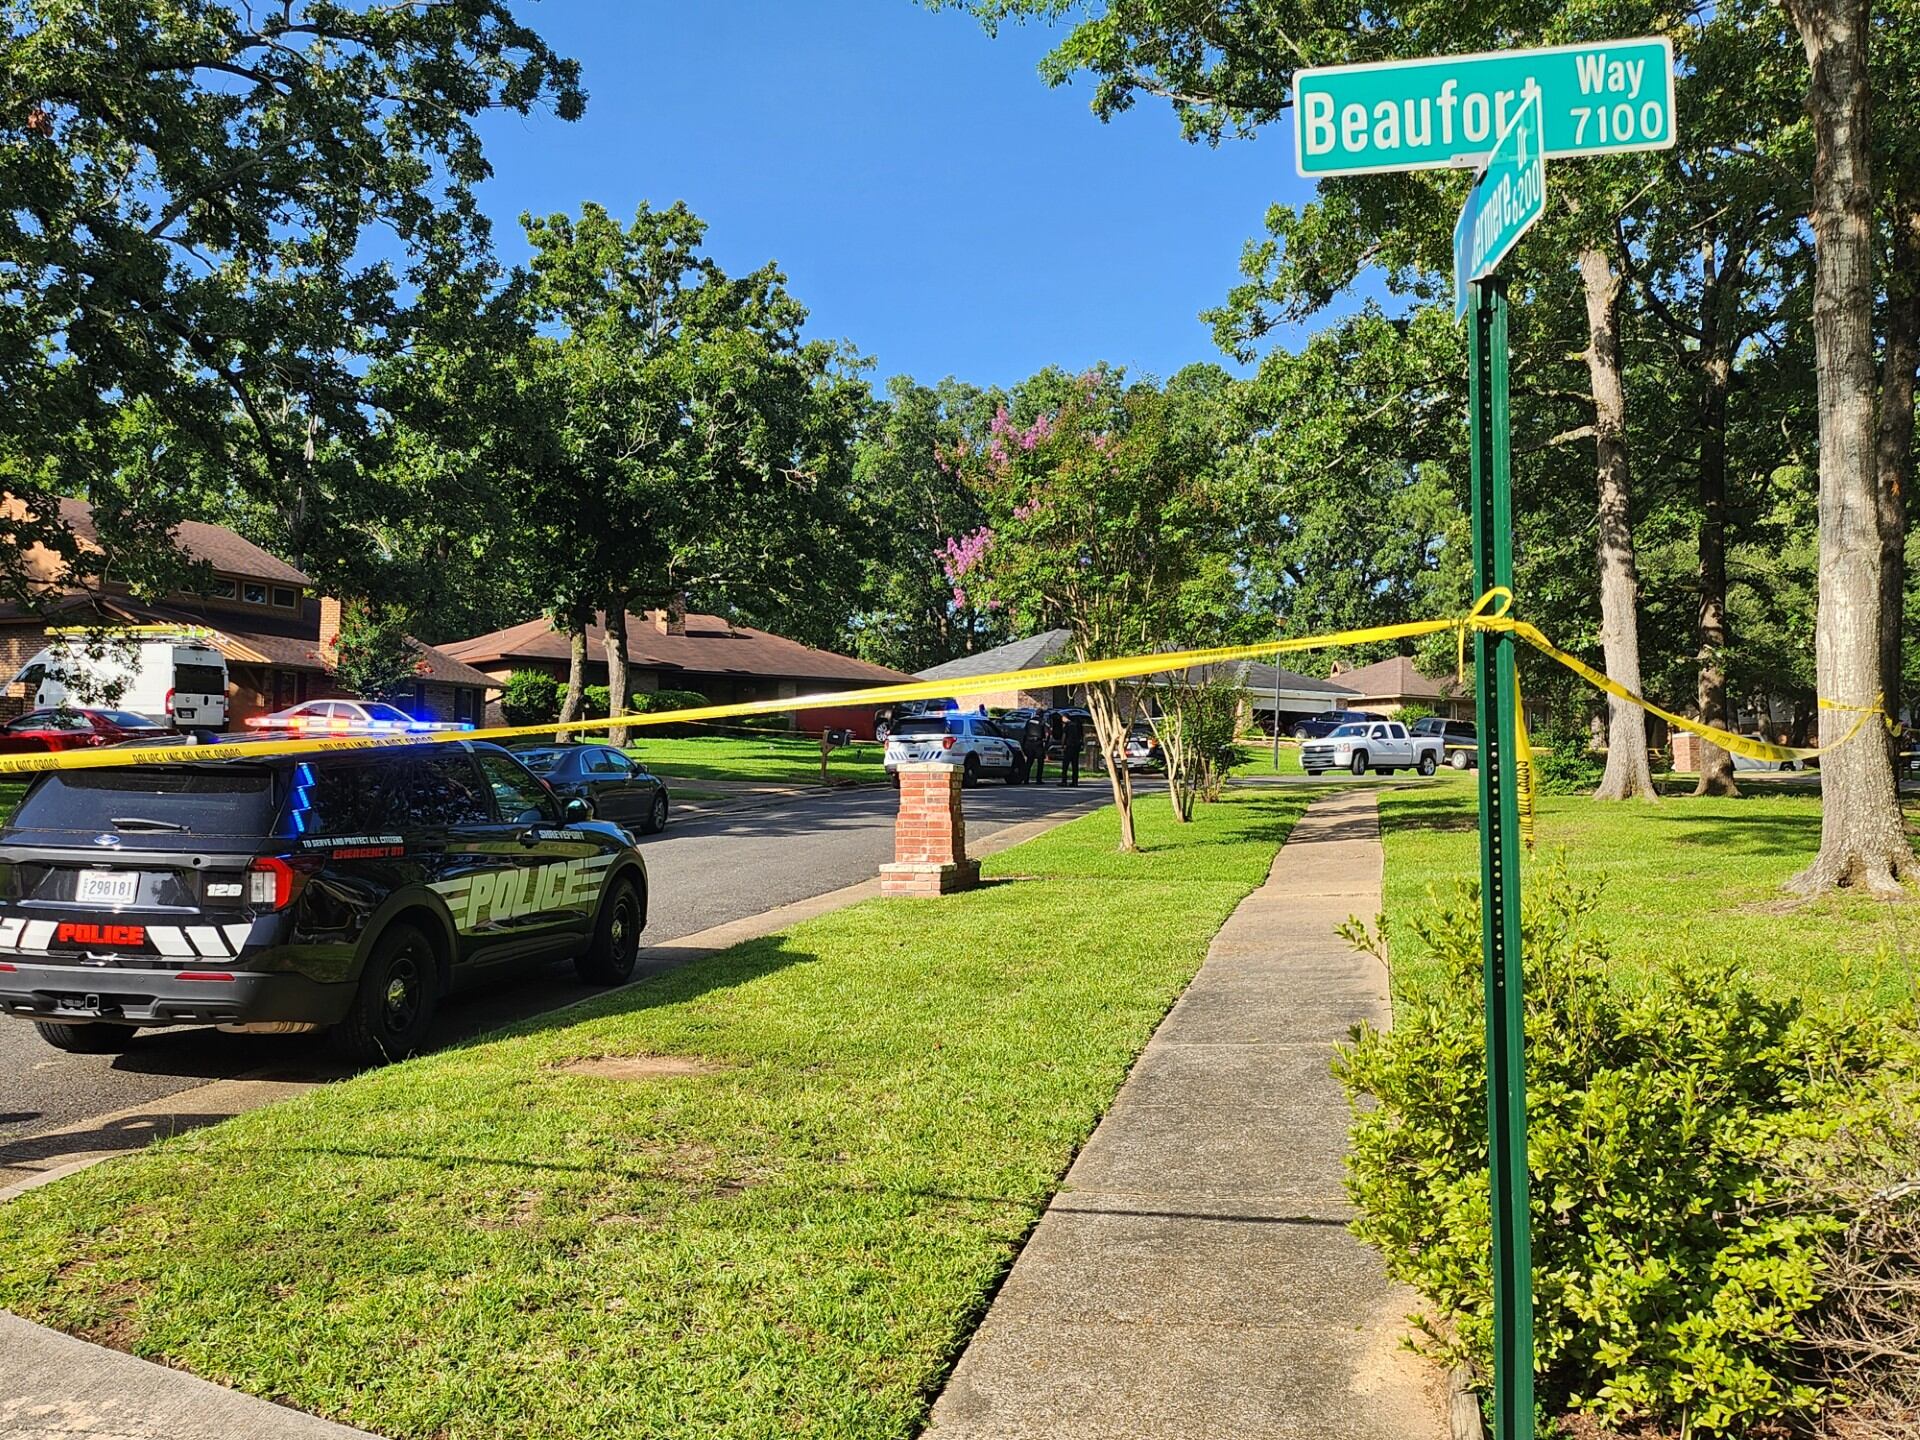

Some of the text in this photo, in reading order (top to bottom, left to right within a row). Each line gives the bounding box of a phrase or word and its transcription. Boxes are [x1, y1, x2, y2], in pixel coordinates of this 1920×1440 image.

[1575, 52, 1645, 99] Way
[1570, 100, 1663, 145] 7100
[1512, 159, 1541, 226] 6200
[302, 835, 404, 848] TO SERVE AND PROTECT ALL CITIZENS
[538, 829, 586, 841] SHREVEPORT
[333, 847, 390, 859] EMERGENCY
[89, 880, 132, 896] 298181
[206, 883, 243, 897] 128
[466, 858, 586, 929] POLICE
[58, 922, 145, 946] POLICE
